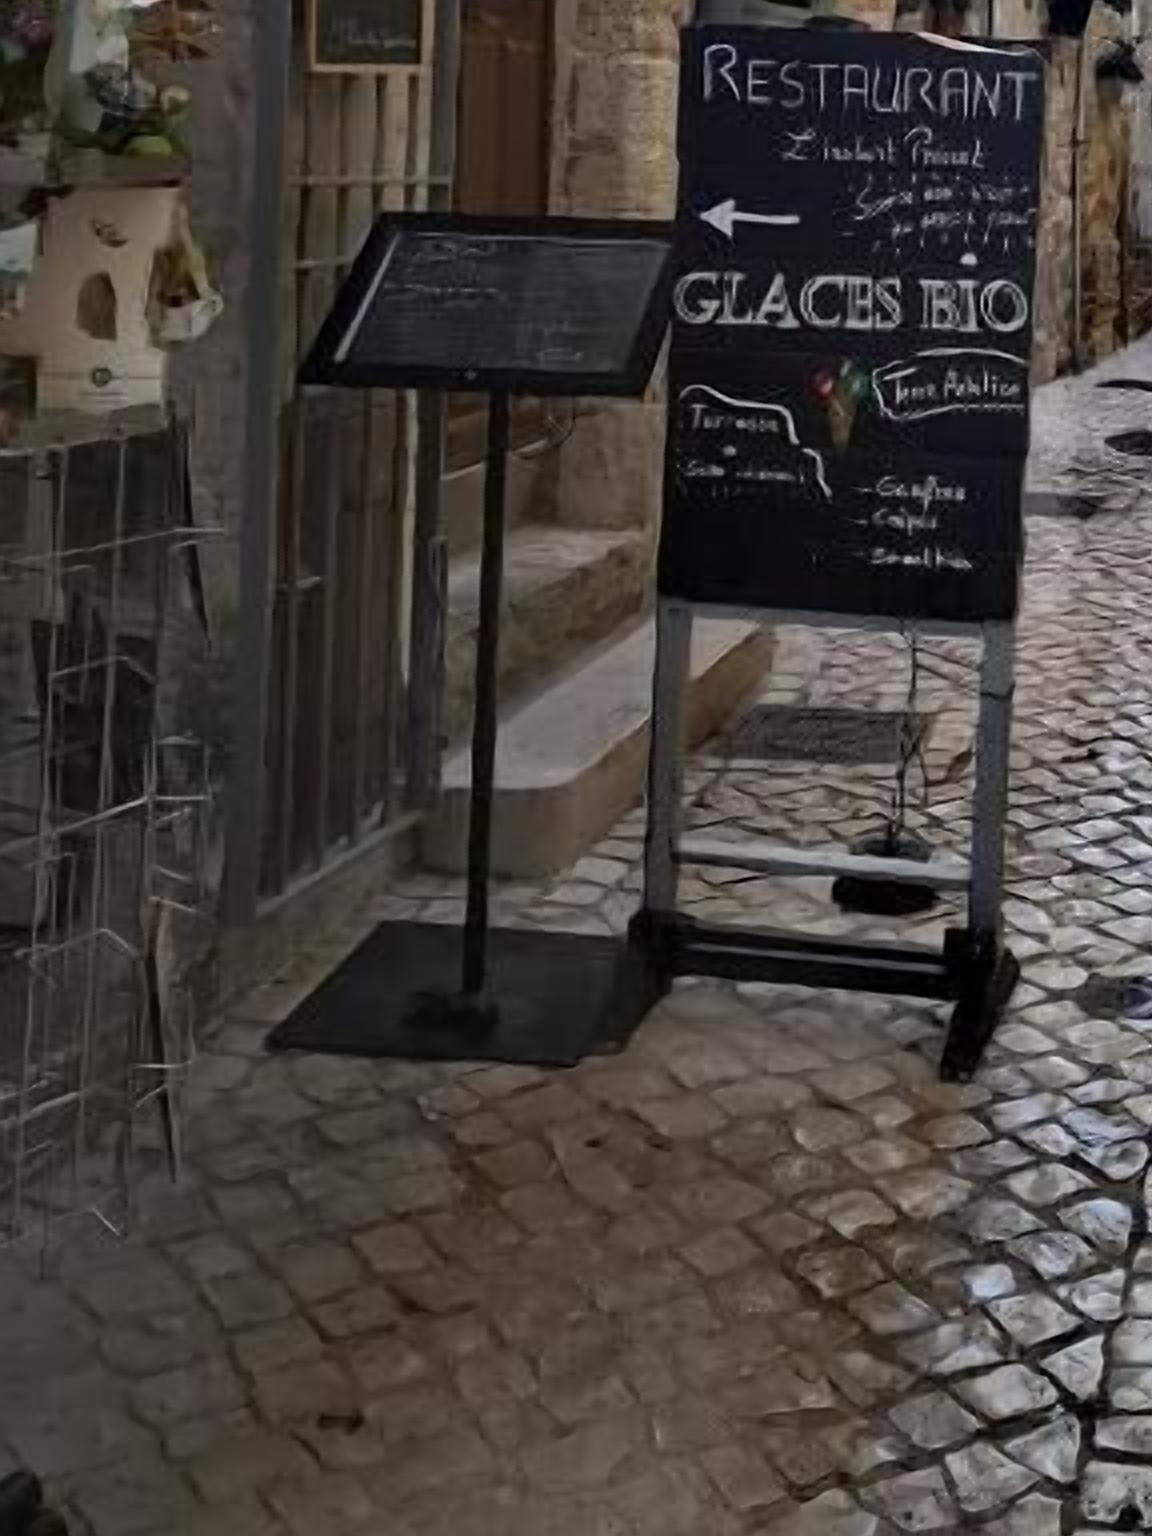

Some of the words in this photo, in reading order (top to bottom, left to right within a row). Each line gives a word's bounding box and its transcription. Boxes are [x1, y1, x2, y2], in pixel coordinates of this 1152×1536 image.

[702, 43, 1038, 122] RESTAURANT
[673, 271, 901, 330] GLACES
[917, 278, 1029, 333] BIO
